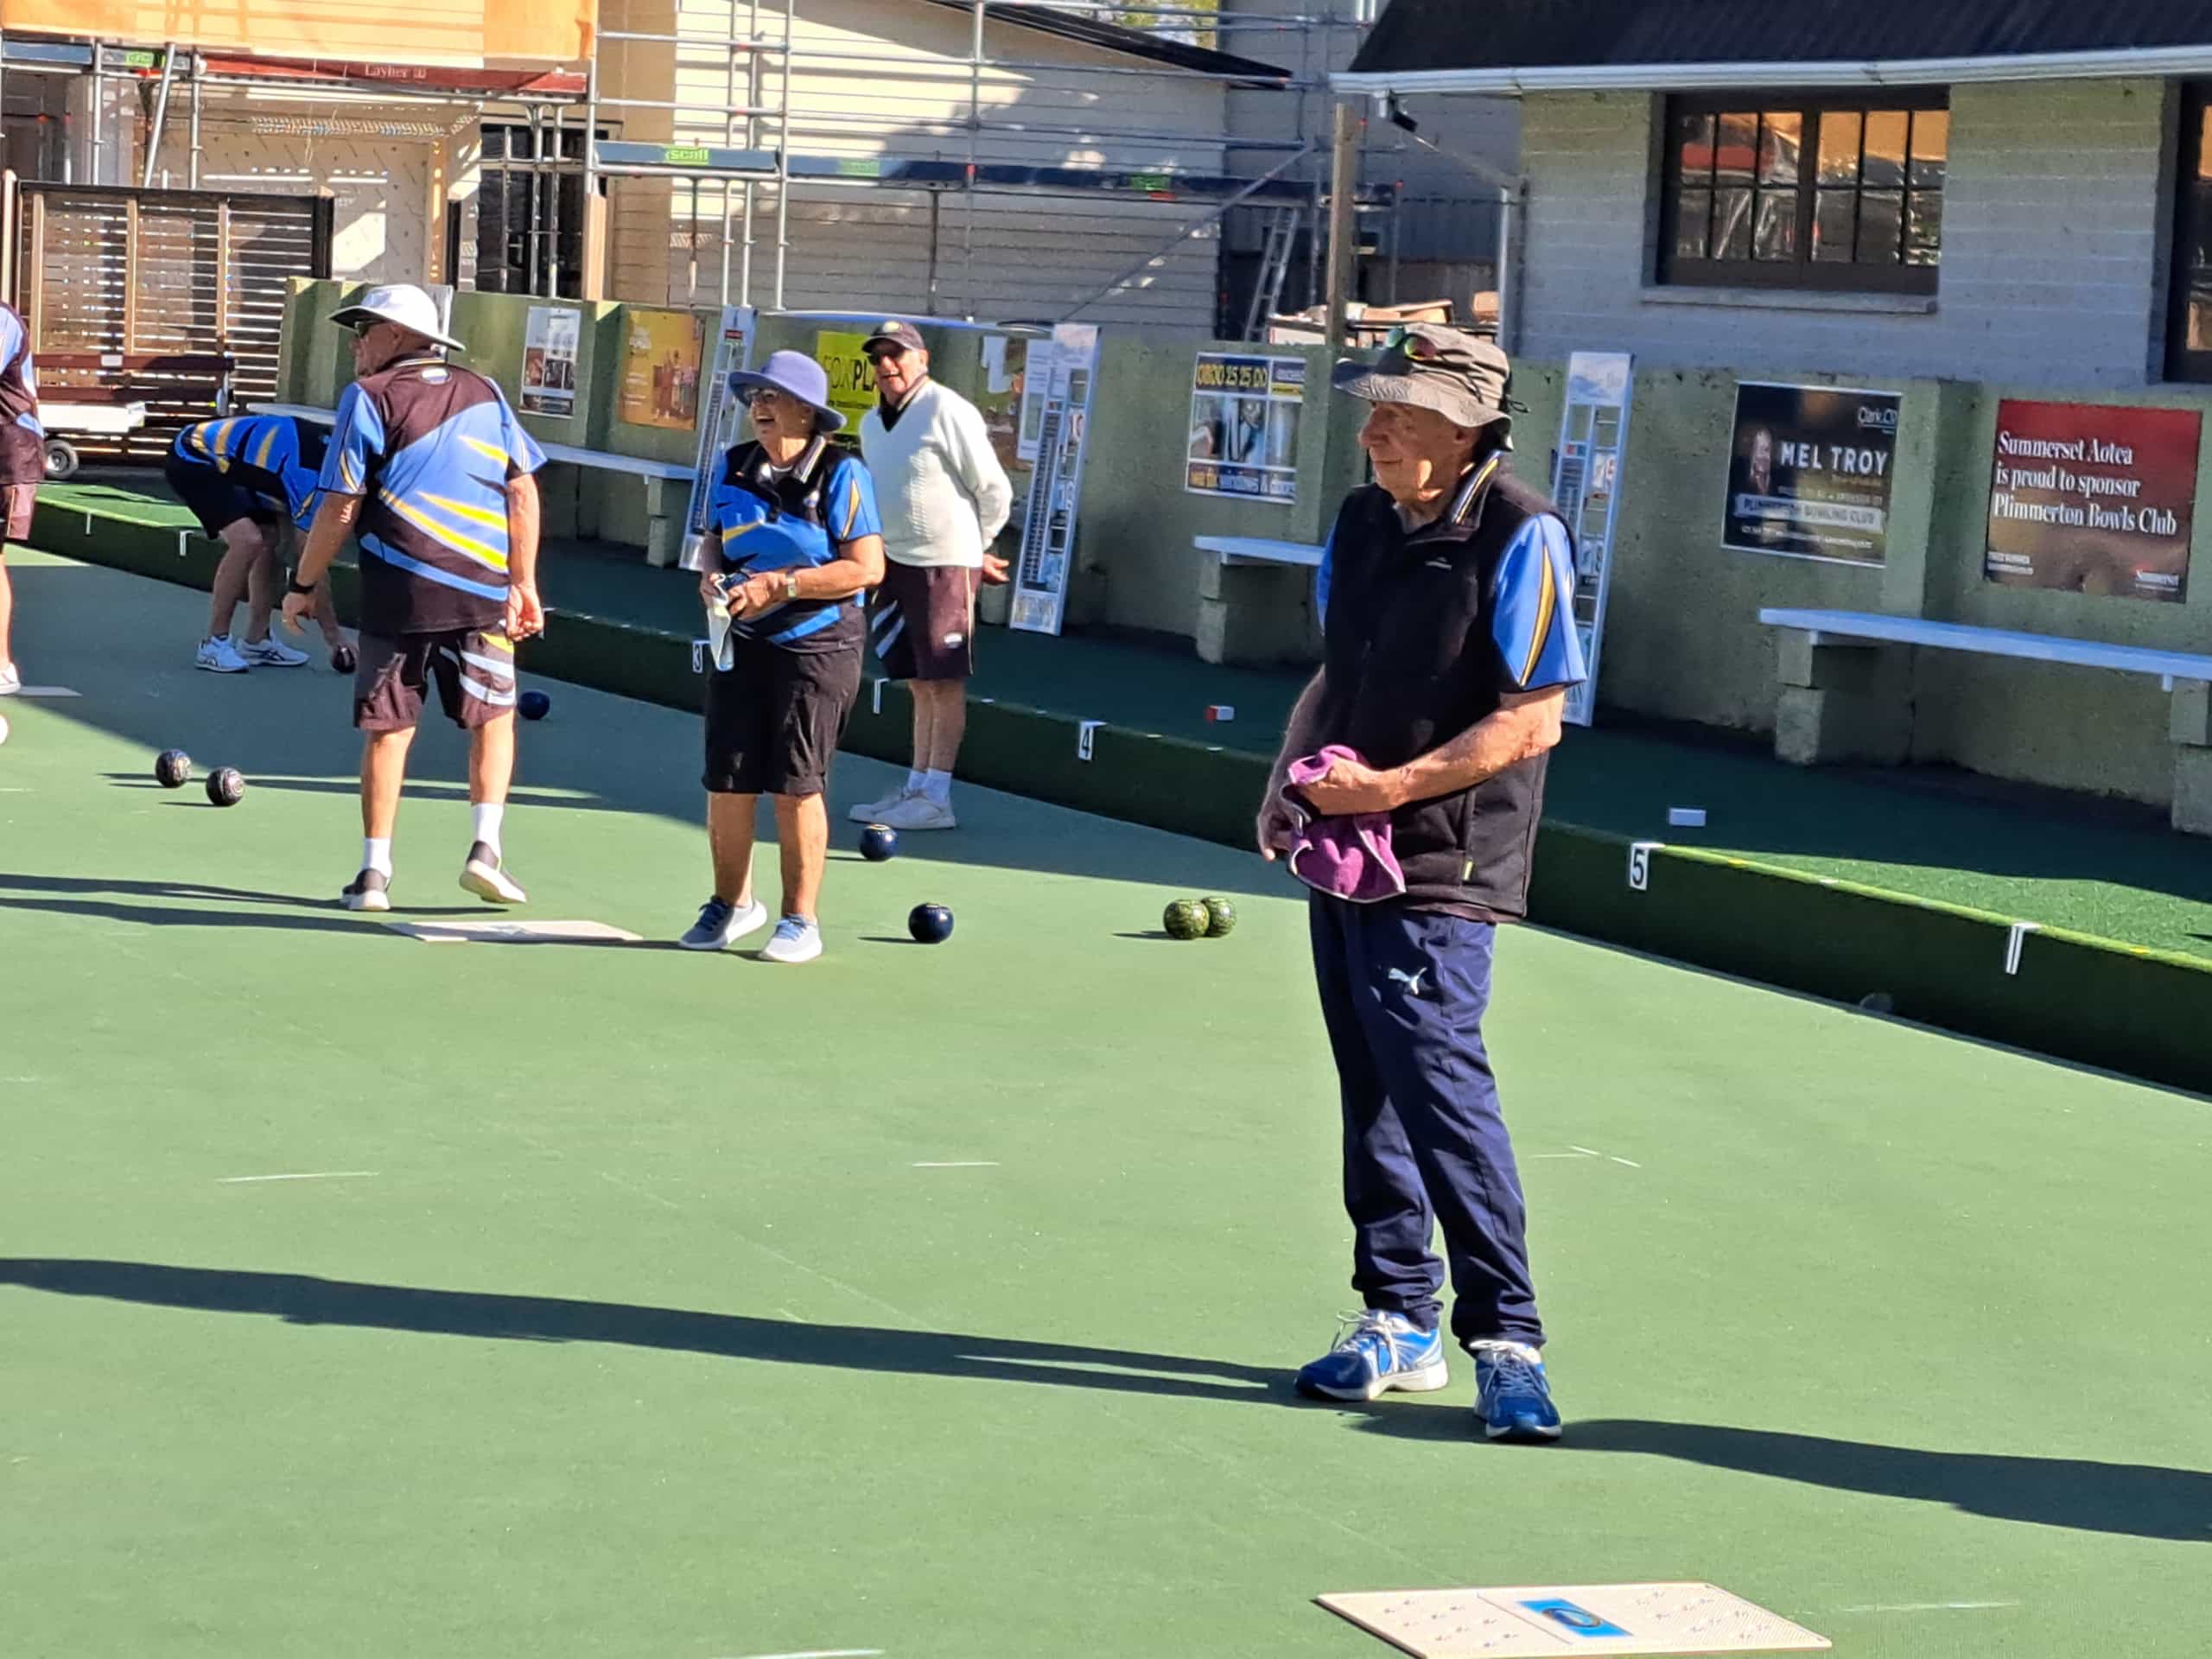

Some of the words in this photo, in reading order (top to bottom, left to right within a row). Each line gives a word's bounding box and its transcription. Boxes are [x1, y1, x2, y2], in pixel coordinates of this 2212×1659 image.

[1780, 442, 1822, 469] MEL
[1831, 447, 1888, 475] TROY
[1998, 430, 2085, 461] Summerset
[2088, 438, 2133, 465] Aotea
[1996, 461, 2008, 485] is
[2011, 466, 2056, 491] proud
[2060, 467, 2075, 492] to
[2078, 475, 2140, 498] sponsor
[1994, 493, 2084, 525] Plimmerton
[2088, 503, 2135, 531] Bowls
[2139, 508, 2177, 535] Club
[1081, 728, 1090, 758] 4
[1631, 849, 1644, 886] 5
